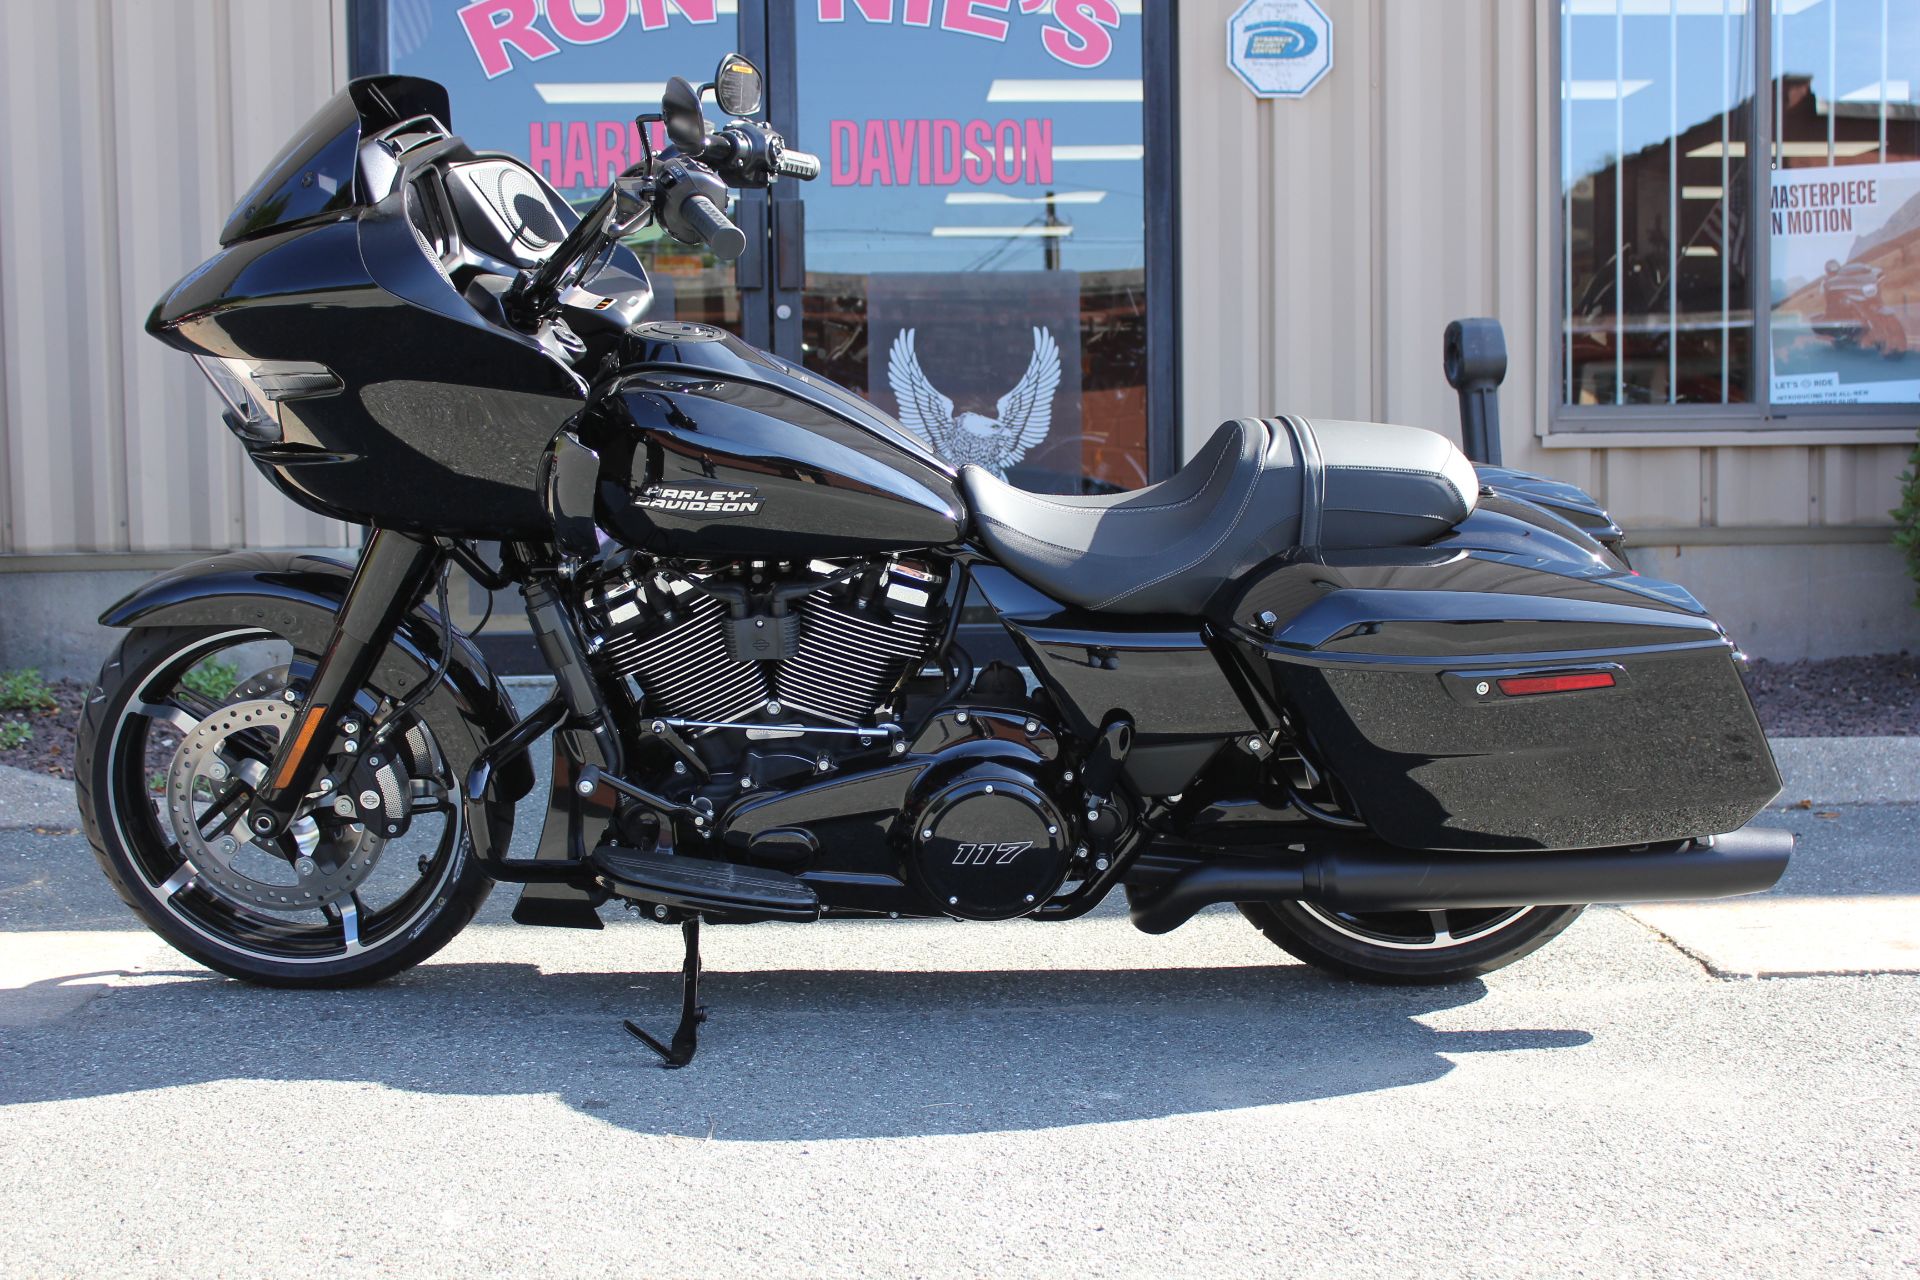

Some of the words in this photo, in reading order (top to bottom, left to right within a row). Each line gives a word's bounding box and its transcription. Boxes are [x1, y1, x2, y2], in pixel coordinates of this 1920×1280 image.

[529, 121, 667, 189] HAR
[829, 118, 1054, 187] DAVIDSON
[1787, 208, 1852, 234] MOTION
[1813, 379, 1833, 387] RIDE
[634, 496, 758, 512] DAVIDSON
[952, 841, 1034, 865] 117
